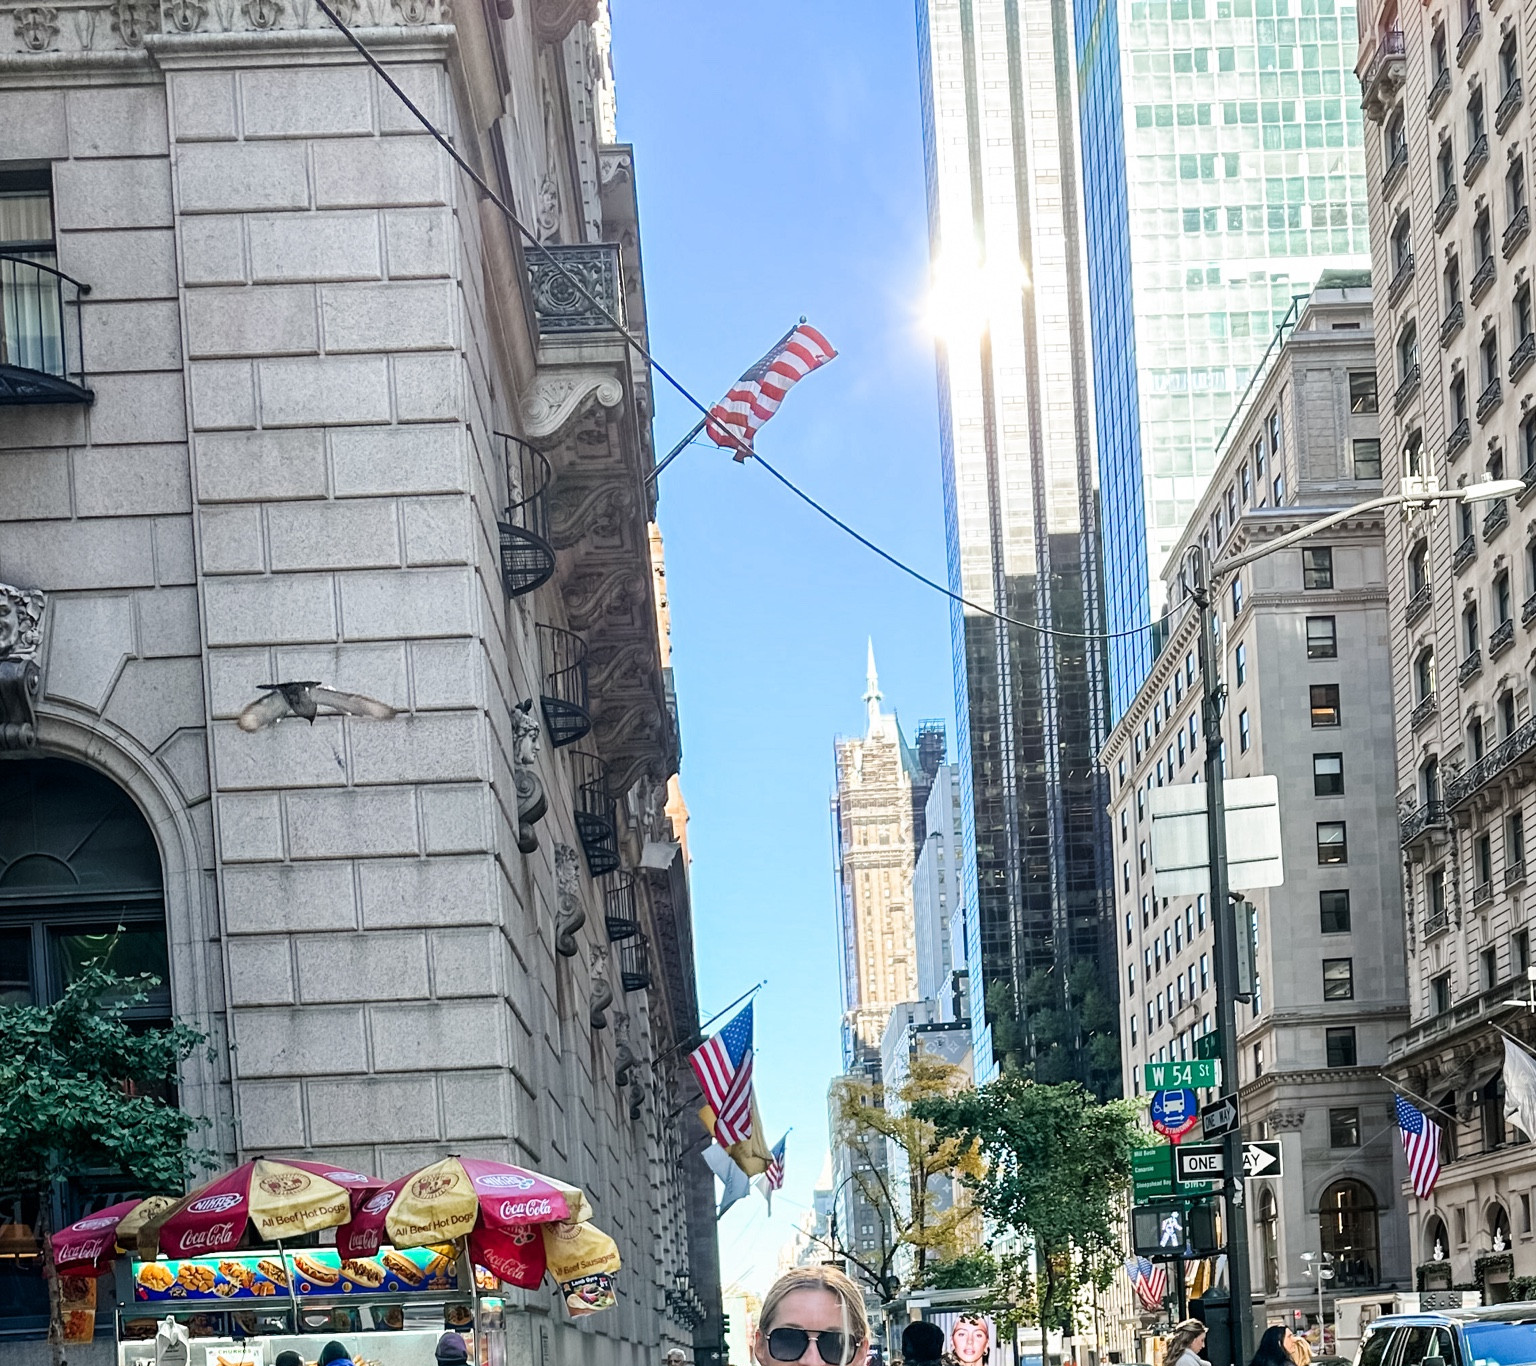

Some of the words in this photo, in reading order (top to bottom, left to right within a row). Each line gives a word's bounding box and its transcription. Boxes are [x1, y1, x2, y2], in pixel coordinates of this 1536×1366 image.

[1152, 1067, 1164, 1087] W
[1172, 1065, 1192, 1086] 54
[1199, 1064, 1209, 1077] St
[1205, 1115, 1215, 1129] ONE
[1220, 1108, 1231, 1121] WAY
[1189, 1156, 1217, 1170] ONE
[1243, 1154, 1260, 1167] AY
[262, 1216, 274, 1228] All
[277, 1212, 299, 1226] Beef
[300, 1209, 319, 1220] Hot
[319, 1203, 346, 1216] Dogs
[500, 1199, 552, 1220] Coca-Cola
[395, 1227, 407, 1237] All
[410, 1222, 432, 1235] Beef
[433, 1218, 450, 1230] Hot
[451, 1212, 473, 1225] Dogs
[179, 1222, 234, 1250] Coca-Cola
[563, 1262, 580, 1275] Beef
[580, 1253, 616, 1269] Sausages
